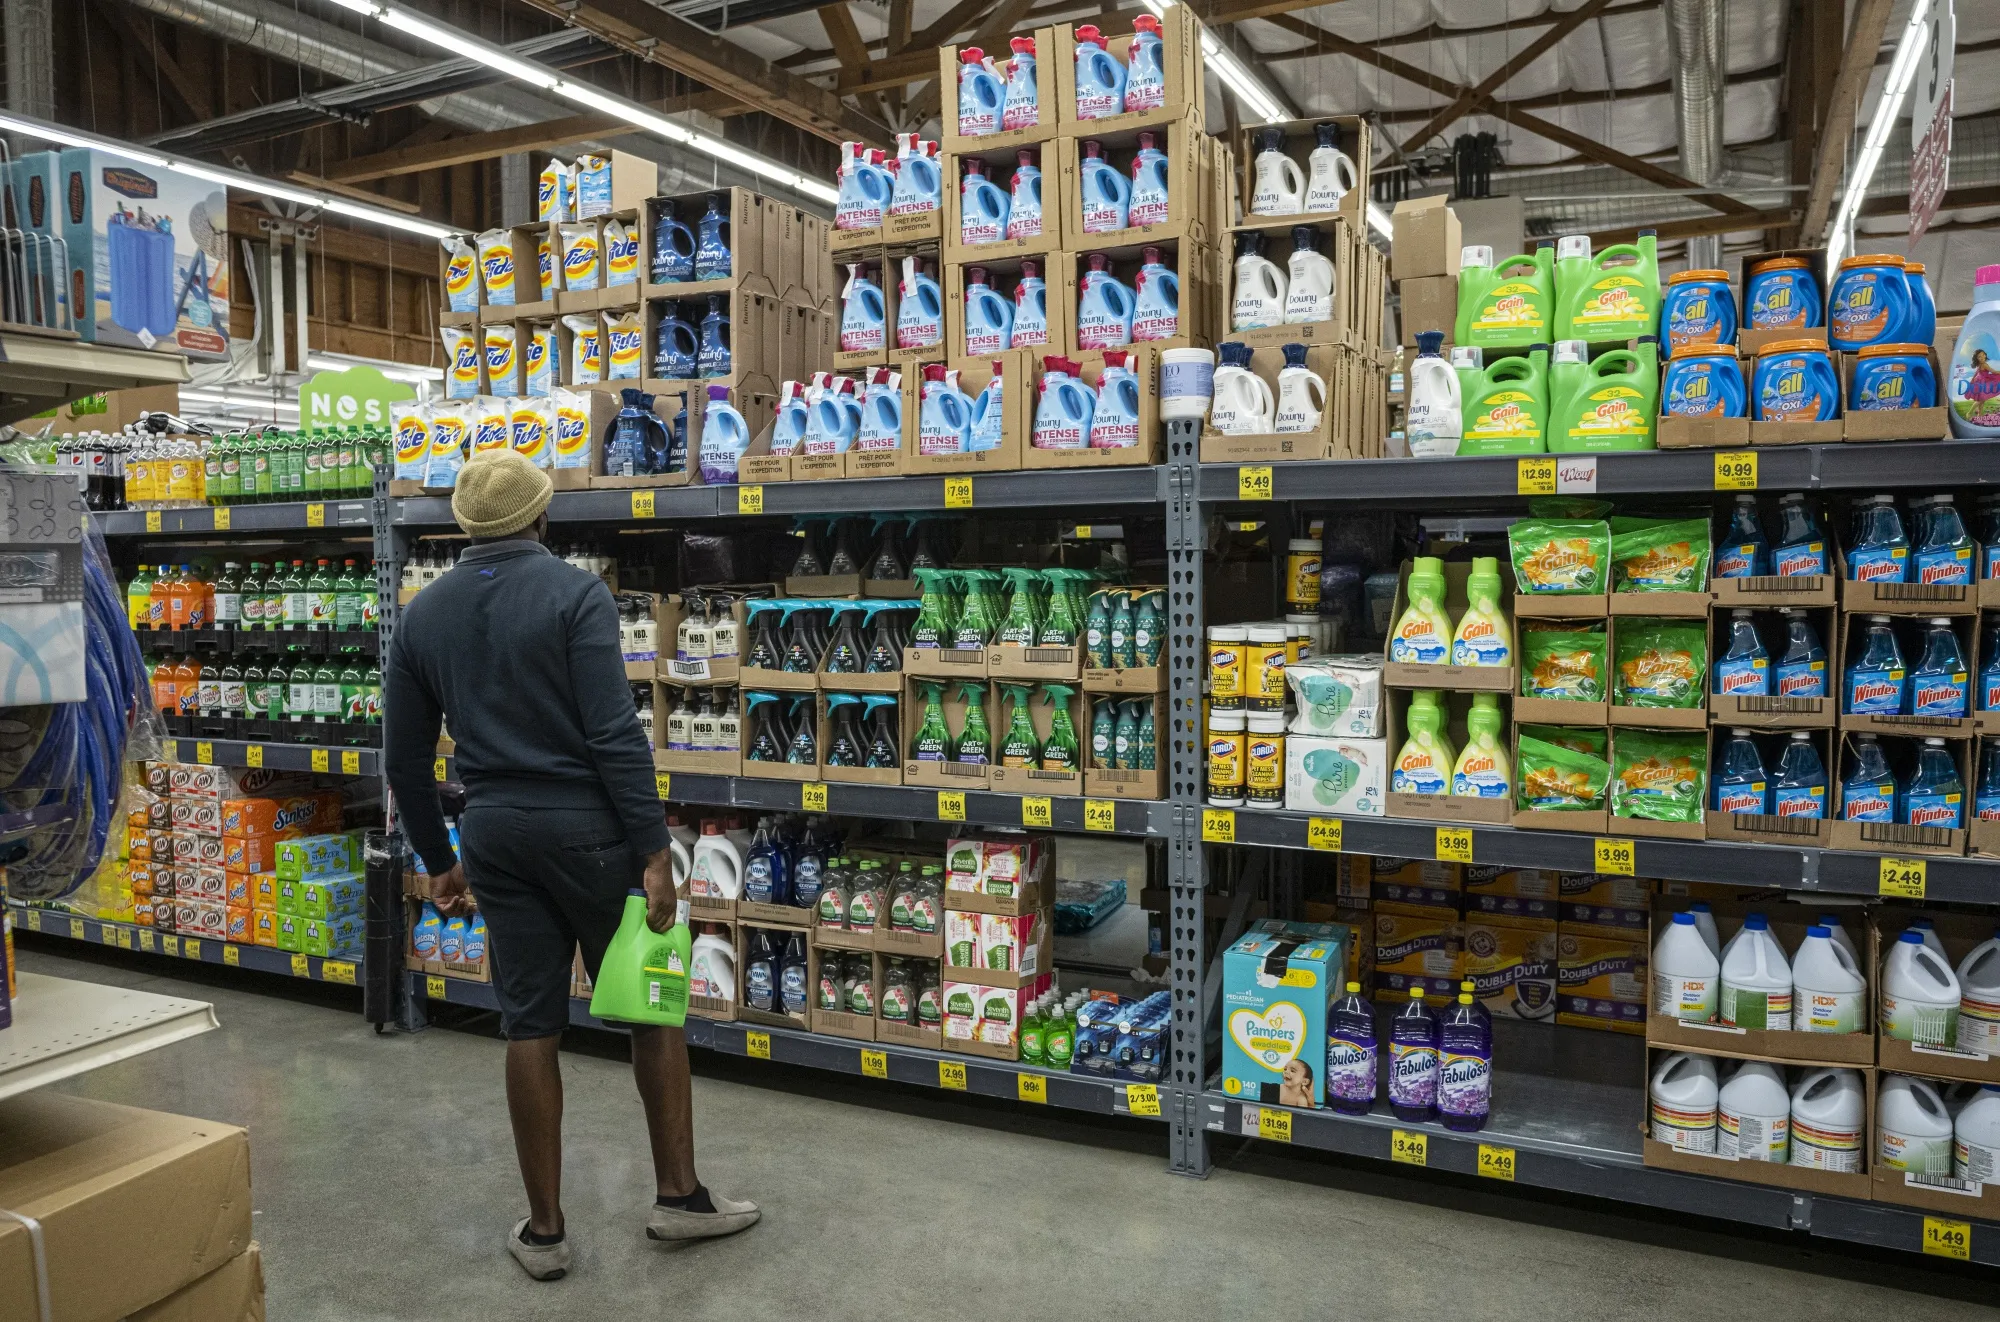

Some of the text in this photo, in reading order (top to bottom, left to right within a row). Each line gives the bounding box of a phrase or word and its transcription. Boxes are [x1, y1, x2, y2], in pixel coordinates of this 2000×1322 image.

[1254, 192, 1279, 203] Downy
[1311, 190, 1339, 200] Downy
[837, 208, 880, 221] INTENSE
[564, 248, 599, 268] Tide
[485, 259, 514, 276] Tide
[1506, 285, 1518, 293] 32
[1609, 278, 1623, 287] 32
[1235, 298, 1261, 309] Downy
[1289, 293, 1317, 305] Downy
[1600, 290, 1628, 305] Gain
[1768, 289, 1789, 309] all
[1850, 288, 1871, 307] all
[1497, 297, 1525, 312] Gain
[1685, 301, 1706, 320] all
[1770, 315, 1788, 324] OXI
[1850, 313, 1868, 323] OXI
[1687, 325, 1703, 334] OXI
[1148, 347, 1157, 396] Downy
[1165, 365, 1180, 377] EO
[1685, 377, 1707, 397] all
[1780, 374, 1801, 395] all
[1877, 377, 1902, 399] all
[1500, 394, 1512, 402] 32
[1606, 389, 1620, 399] 32
[1596, 401, 1627, 417] Gain
[1688, 404, 1705, 413] OXI
[1781, 401, 1801, 411] OXI
[1278, 411, 1305, 423] Downy
[1490, 405, 1519, 421] Gain
[512, 423, 541, 443] Tide
[1033, 429, 1080, 438] INTENSE
[1091, 424, 1138, 436] INTENSE
[1522, 468, 1551, 481] $12.99
[1718, 463, 1752, 477] $9.99
[1241, 475, 1270, 489] $5.49
[1540, 553, 1578, 571] Gain
[1780, 557, 1820, 576] Windex
[1857, 564, 1900, 581] Windex
[1921, 565, 1965, 583] Windex
[634, 630, 648, 639] NBD.
[1402, 621, 1434, 638] Gain
[1462, 623, 1494, 639] Gain
[689, 633, 706, 644] NBD.
[1723, 674, 1763, 693] Windex
[1780, 676, 1820, 695] Windex
[1854, 685, 1898, 704] Windex
[1917, 687, 1962, 707] Windex
[669, 719, 684, 731] NBD.
[694, 723, 714, 734] NBD.
[721, 723, 738, 733] NBD.
[961, 746, 984, 754] GREEN
[1402, 754, 1432, 771] Gain
[1463, 759, 1494, 773] Gain
[1322, 762, 1343, 794] Pure
[1640, 767, 1677, 781] Gain
[804, 791, 825, 803] $2.99
[1366, 787, 1373, 795] 76
[941, 801, 961, 812] $1.99
[1721, 797, 1761, 813] Windex
[1779, 802, 1819, 818] Windex
[1847, 801, 1889, 818] Windex
[274, 801, 318, 830] Sunkist
[1026, 807, 1047, 817] $1.99
[1087, 809, 1112, 820] $2.49
[1911, 808, 1955, 826] Windex
[1205, 821, 1231, 831] $2.99
[1310, 826, 1340, 838] $24.99
[1439, 837, 1468, 850] $3.99
[1598, 849, 1629, 861] $3.99
[1883, 868, 1921, 885] $2.49
[1378, 938, 1439, 957] DOUBLE DUTY
[1467, 964, 1548, 989] DOUBLE DUTY
[1560, 961, 1627, 979] DOUBLE DUTY
[1683, 982, 1705, 991] HDX
[1226, 994, 1264, 1003] PEDIATRICIAN
[1813, 996, 1836, 1006] HDX
[1246, 1020, 1295, 1041] Pampers
[748, 1037, 768, 1050] $4.99
[1251, 1040, 1291, 1051] swaddlers
[864, 1055, 882, 1067] $1.99
[1395, 1055, 1437, 1078] Fabulos
[942, 1068, 964, 1079] $2.99
[1440, 1062, 1488, 1085] Fabuloso
[1243, 1082, 1256, 1090] 140
[1130, 1092, 1156, 1103] 2/3.00
[1262, 1118, 1288, 1131] $31.99
[1394, 1140, 1423, 1154] $3.49
[1884, 1135, 1907, 1148] HDX
[1480, 1153, 1511, 1168] $2.49
[1928, 1229, 1964, 1246] $1.49
